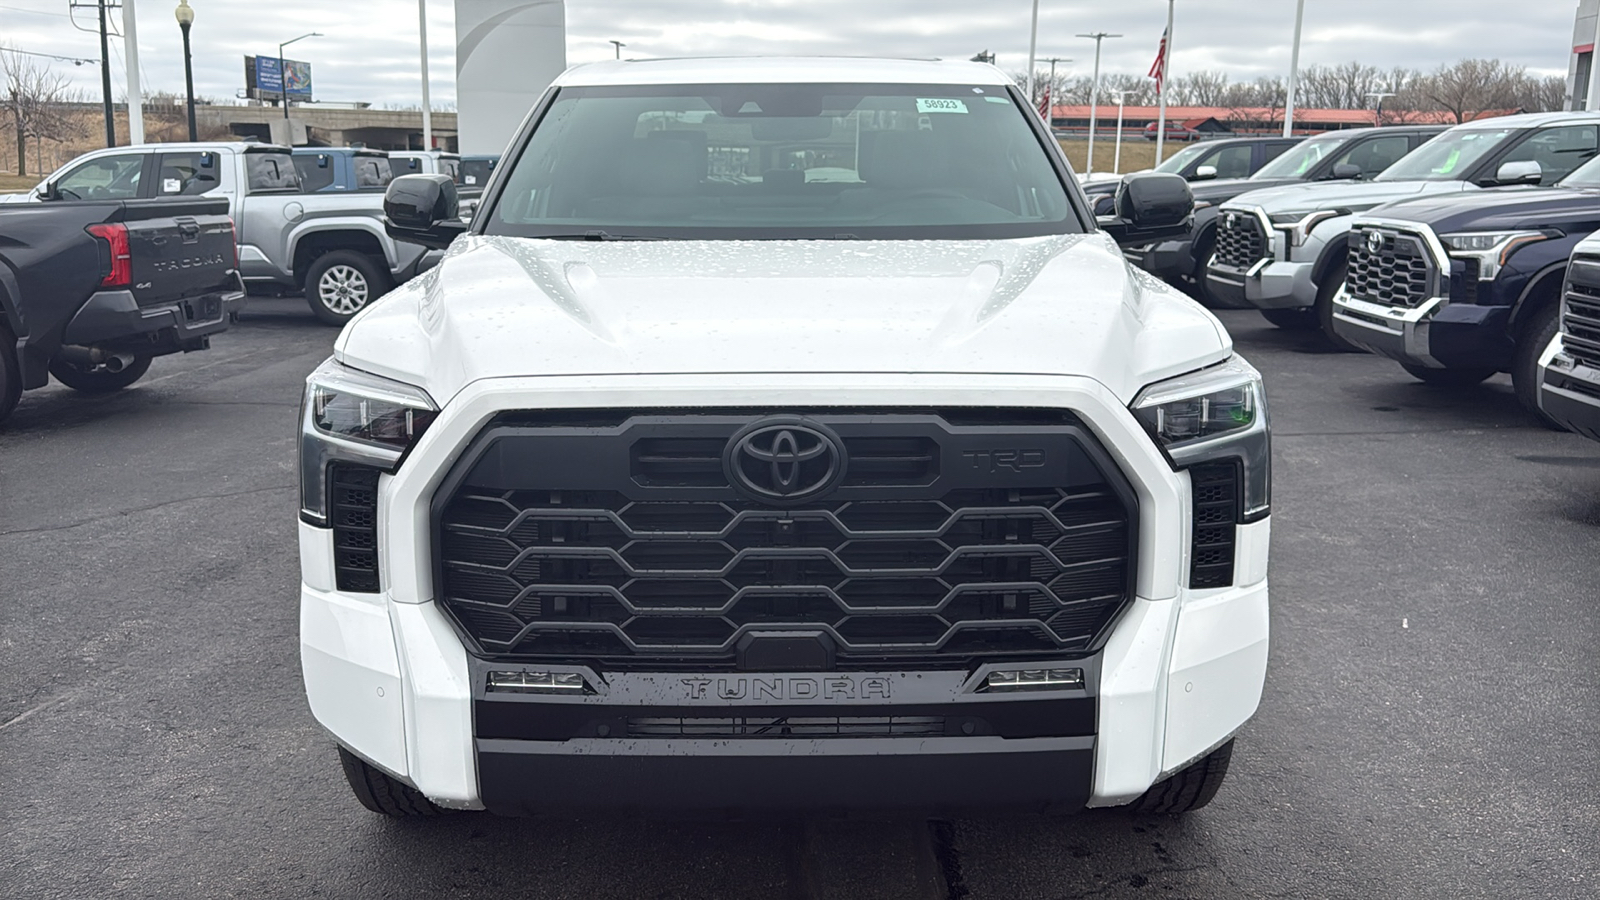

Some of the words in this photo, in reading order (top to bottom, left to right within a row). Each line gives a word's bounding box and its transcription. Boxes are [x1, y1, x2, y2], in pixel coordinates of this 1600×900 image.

[924, 100, 958, 109] 58923
[153, 254, 223, 271] TACOMA
[962, 449, 1046, 473] TRD
[680, 678, 892, 699] TUNDRA
